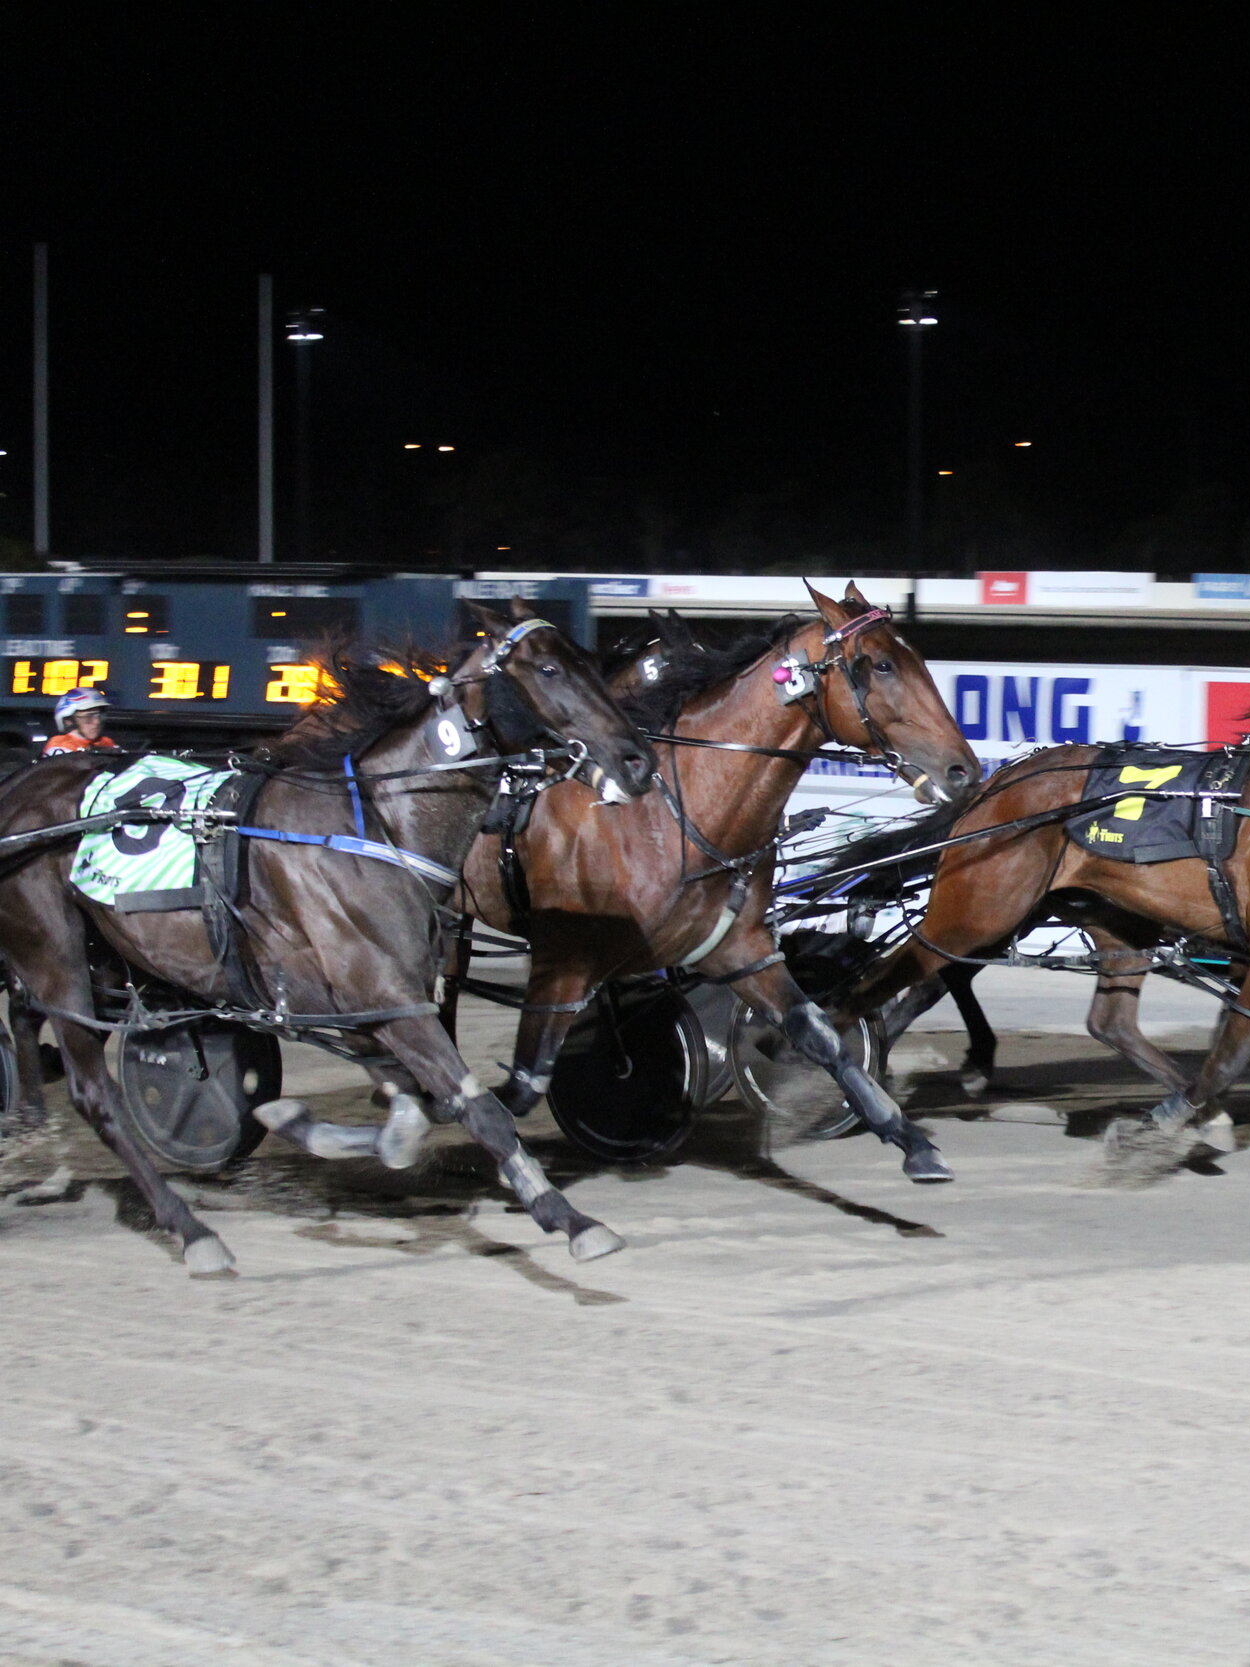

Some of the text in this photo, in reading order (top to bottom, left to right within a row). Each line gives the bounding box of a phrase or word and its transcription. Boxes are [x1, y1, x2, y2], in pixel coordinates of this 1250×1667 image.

[643, 659, 659, 681] 5
[953, 675, 1093, 744] ONG
[437, 719, 461, 756] 9
[1113, 765, 1182, 821] 7
